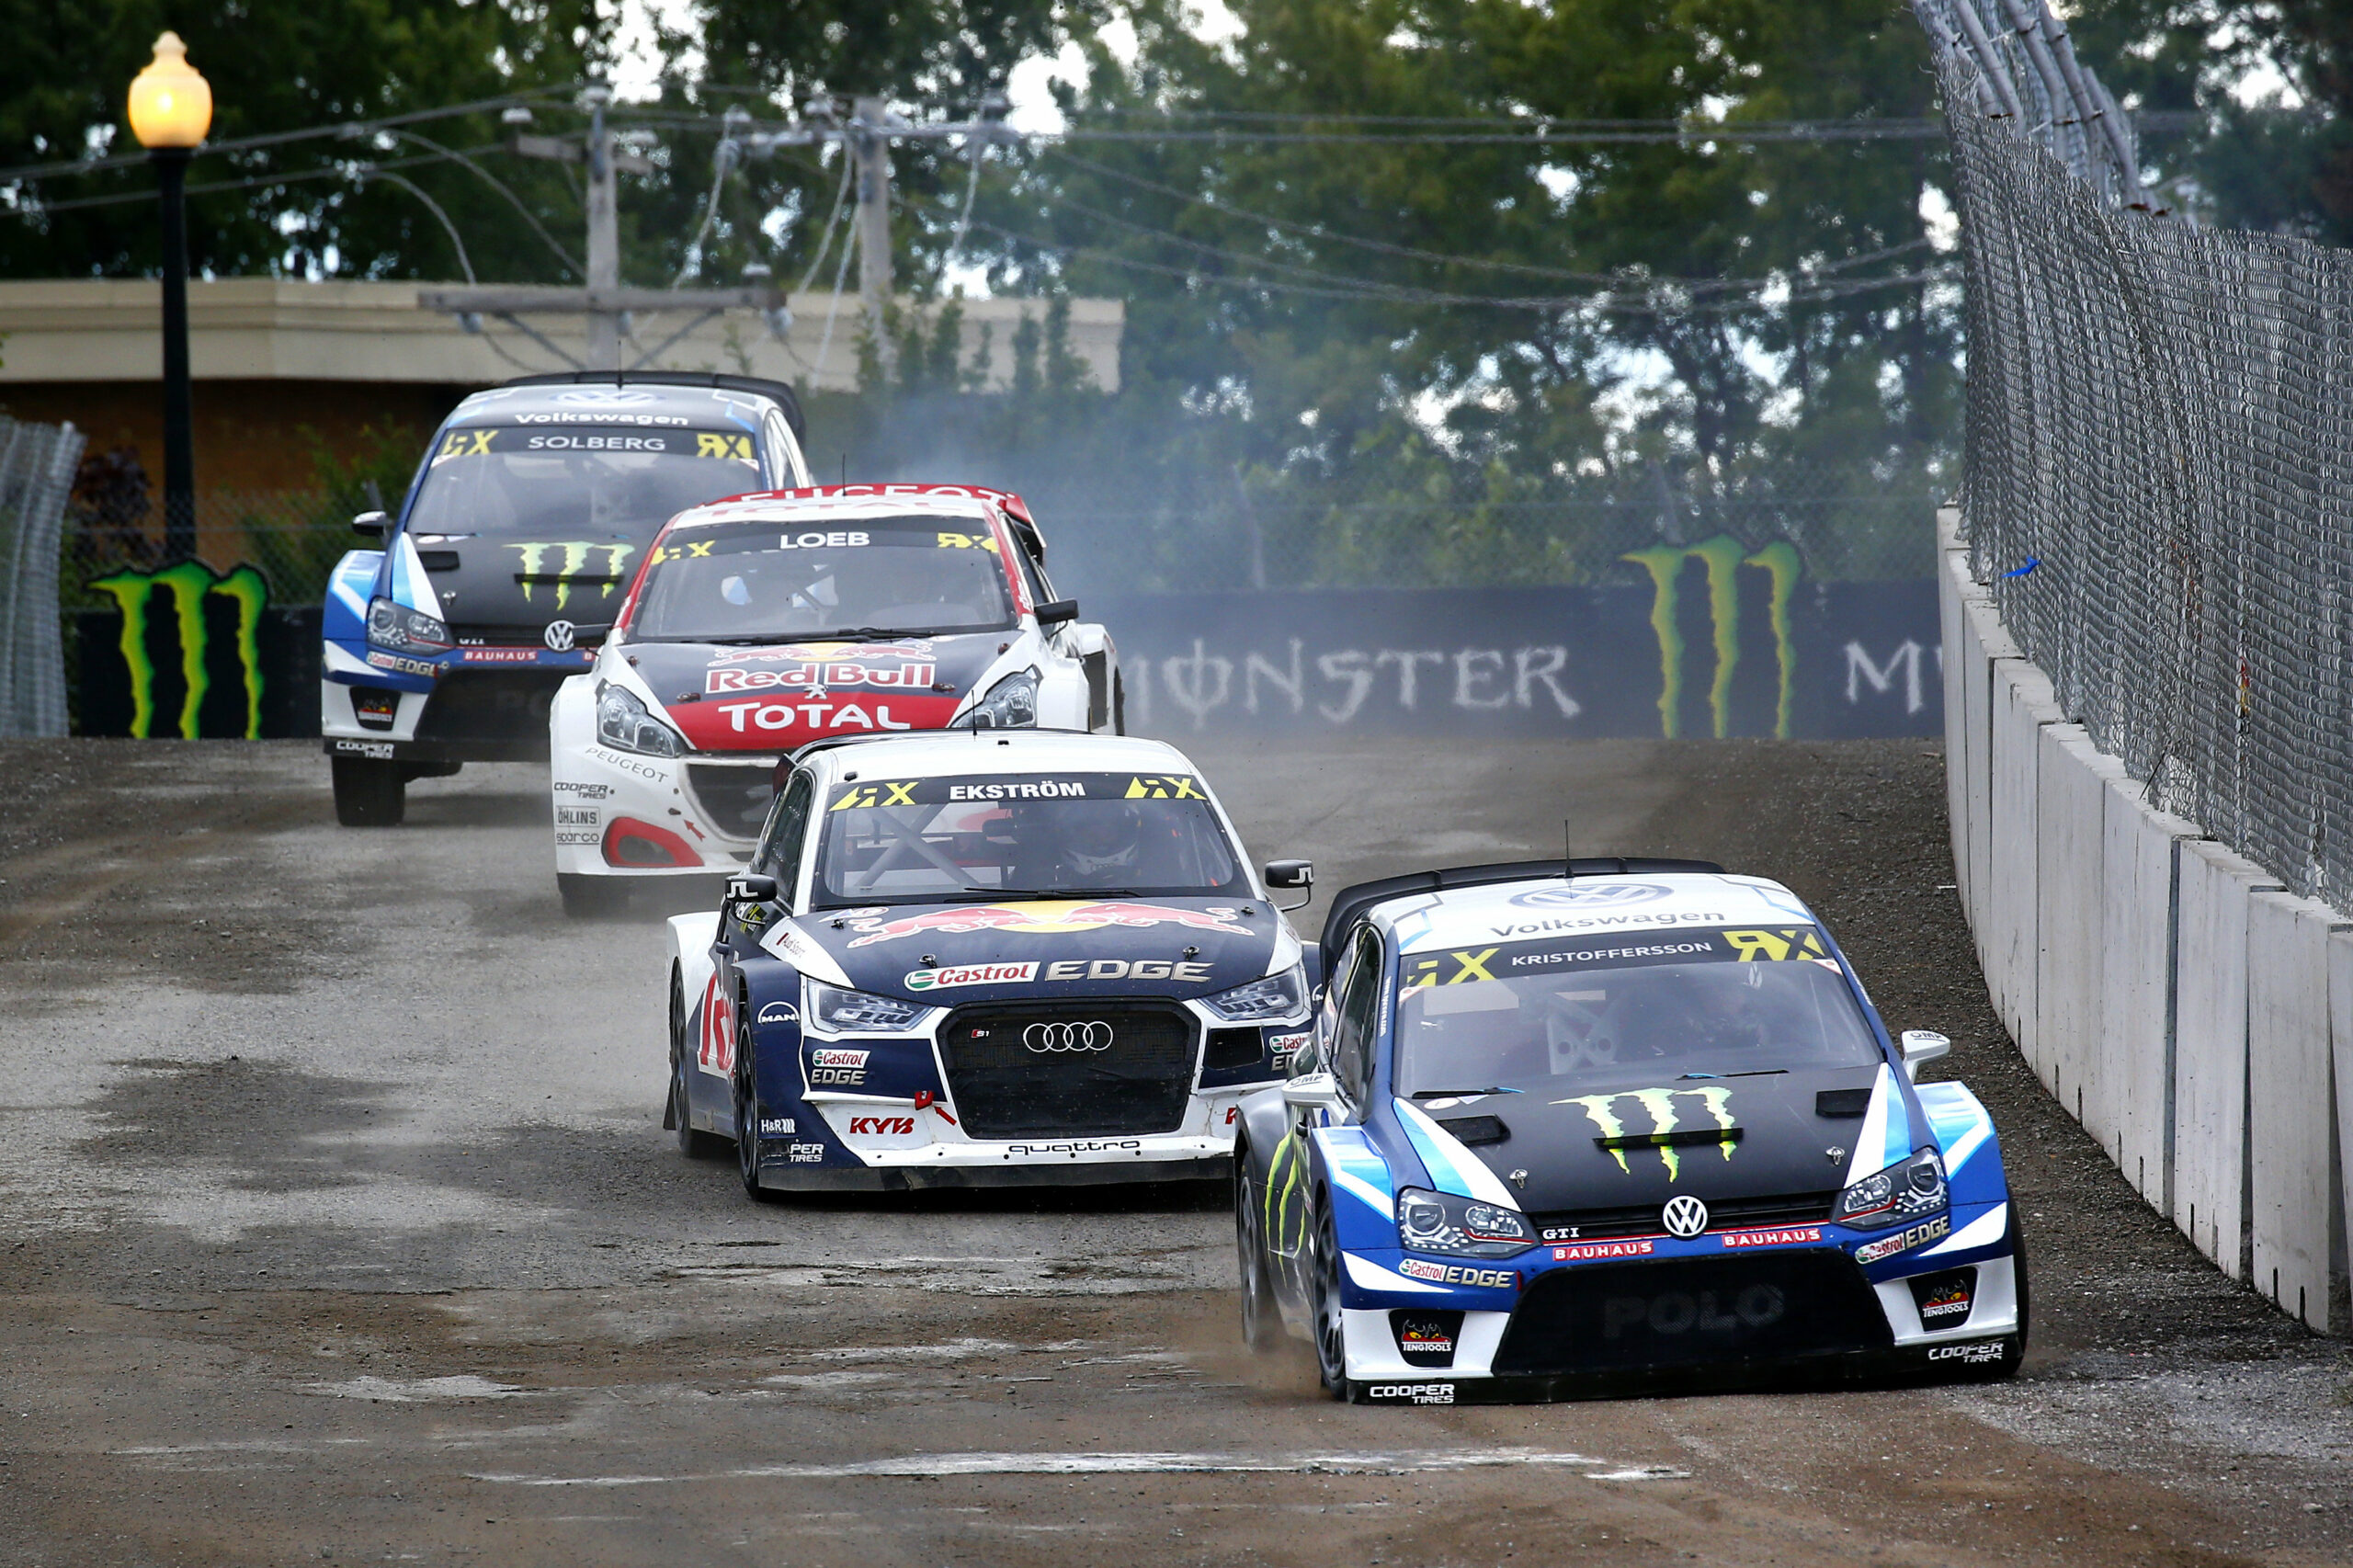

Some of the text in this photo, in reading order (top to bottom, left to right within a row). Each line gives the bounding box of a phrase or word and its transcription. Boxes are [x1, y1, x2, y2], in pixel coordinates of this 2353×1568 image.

[515, 413, 688, 426] Volkswagen
[528, 436, 665, 451] SOLBERG
[779, 531, 870, 550] LOEB
[465, 652, 537, 660] BAUHAUS
[706, 663, 936, 694] Red Bull
[718, 702, 911, 733] TOTAL
[585, 746, 668, 782] PEUGEOT
[553, 782, 608, 792] COOPER
[949, 780, 1086, 801] EKSTRÖM
[577, 791, 607, 800] TIRES
[558, 806, 597, 824] ÖHLINS
[557, 834, 599, 843] sparco
[1489, 911, 1726, 937] Volkswagen
[1512, 942, 1712, 966] KRISTOFFERSSON
[937, 960, 1215, 985] Castrol EDGE
[761, 1013, 797, 1023] MAN
[1283, 1035, 1308, 1051] Cast
[824, 1052, 864, 1066] Castrol
[811, 1069, 868, 1085] EDGE
[1290, 1074, 1324, 1086] OMP
[760, 1119, 784, 1133] H&R
[849, 1118, 915, 1134] KYB
[1008, 1141, 1141, 1155] quattro
[790, 1154, 823, 1163] TIRES
[1542, 1227, 1580, 1240] GTI
[1723, 1229, 1821, 1246] BAUHAUS
[1869, 1215, 1950, 1260] Castrol EDGE
[1554, 1242, 1653, 1260] BAUHAUS
[1409, 1262, 1515, 1289] Castrol EDGE
[1605, 1284, 1784, 1338] POLO
[1927, 1342, 2004, 1360] COOPER
[1963, 1352, 2003, 1363] TIRES
[1370, 1383, 1455, 1398] COOPER
[1412, 1395, 1454, 1404] TIRES
